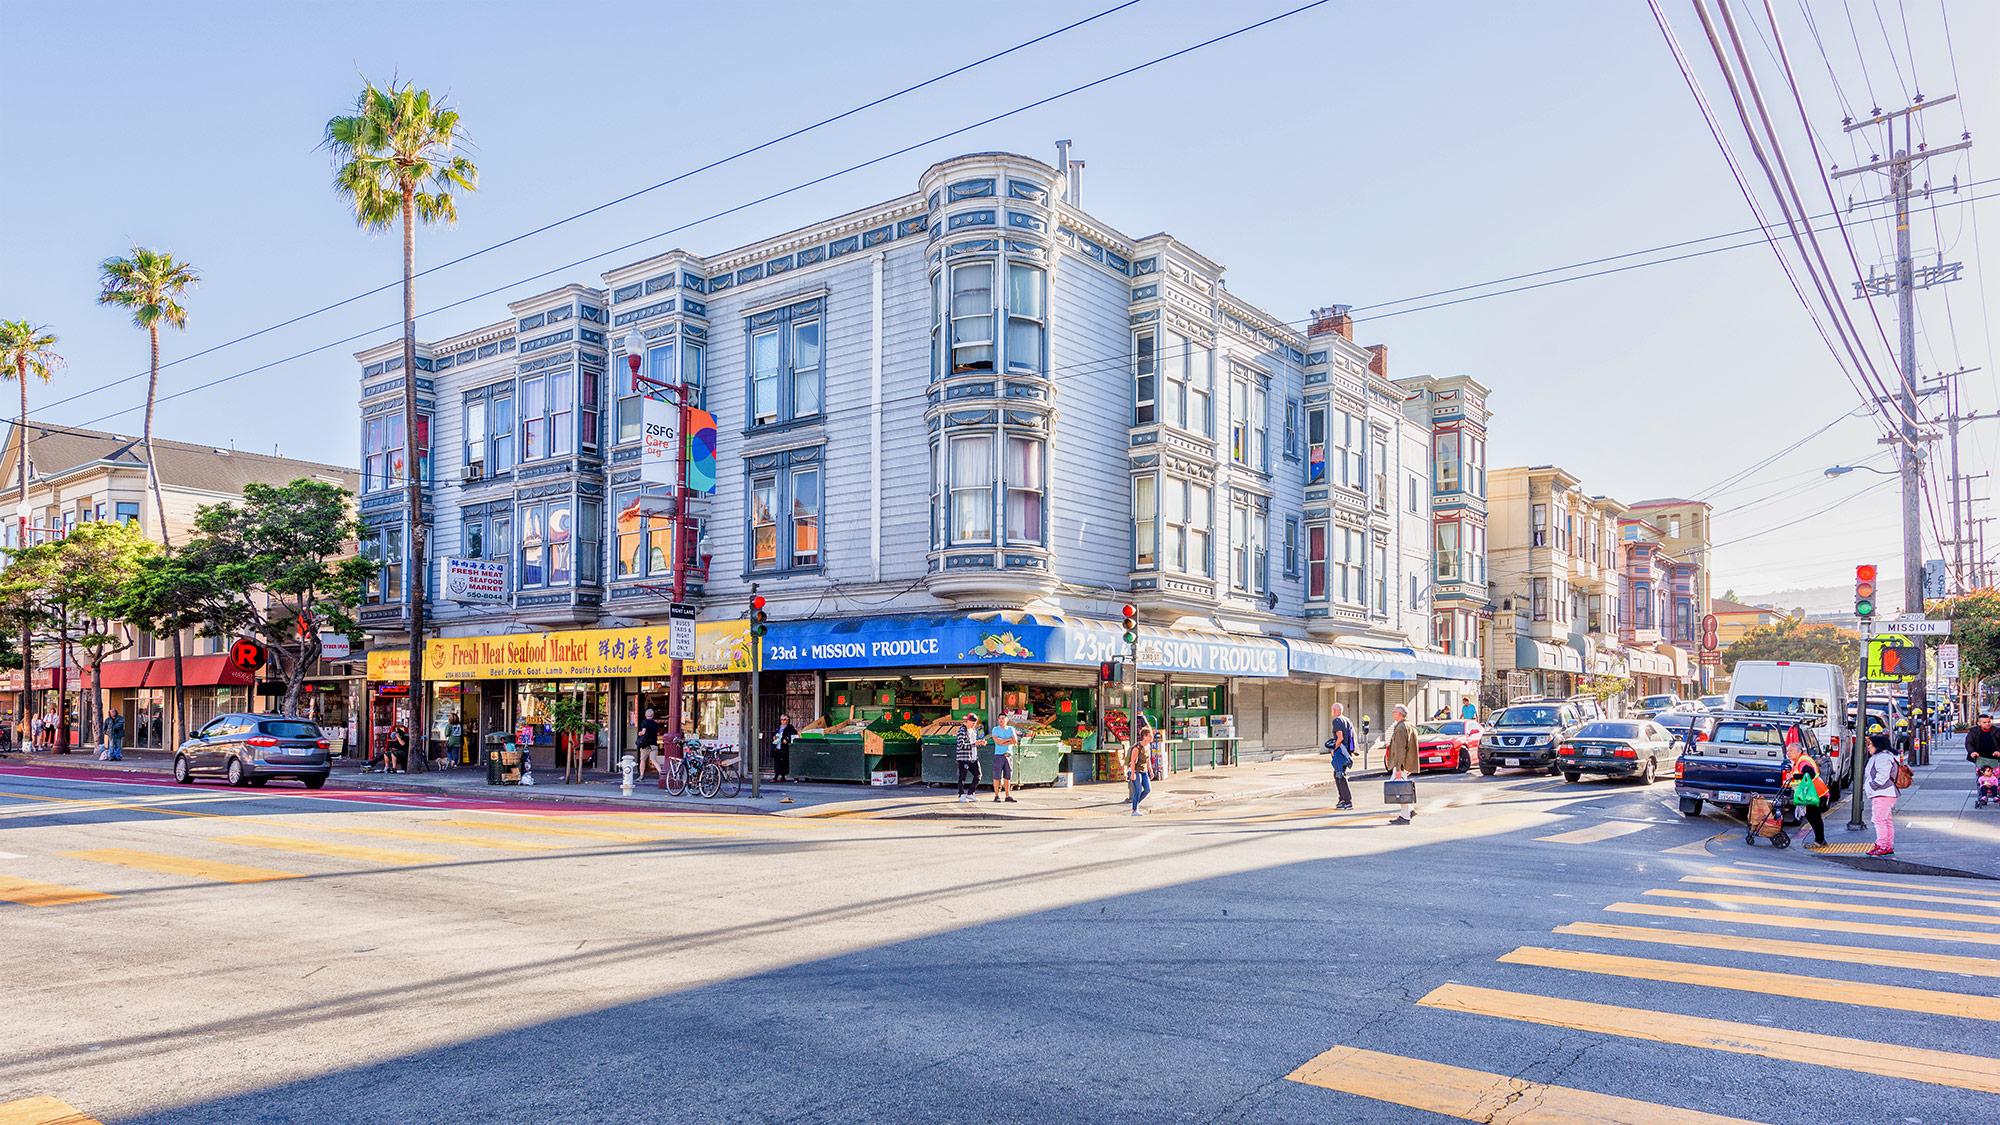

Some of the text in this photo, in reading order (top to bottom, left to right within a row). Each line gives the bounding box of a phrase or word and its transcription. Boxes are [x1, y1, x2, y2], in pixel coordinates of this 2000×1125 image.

[646, 423, 674, 439] ZSFG
[645, 434, 669, 448] Care
[645, 447, 662, 458] .org
[481, 570, 503, 578] MEAT
[468, 577, 504, 585] SEAFOOD
[468, 584, 503, 592] MARKET
[466, 592, 503, 600] 550-8044
[1887, 623, 1935, 632] MISSION
[237, 643, 258, 665] R
[452, 638, 588, 665] Fresh Meat Seafood Market
[771, 638, 939, 660] 23rd & MISSION PRODUCE
[1073, 631, 1114, 662] 23rd
[1208, 645, 1278, 673] PRODUCE
[1943, 660, 1955, 669] 15
[570, 666, 596, 676] Poultry
[603, 665, 632, 674] Seafood
